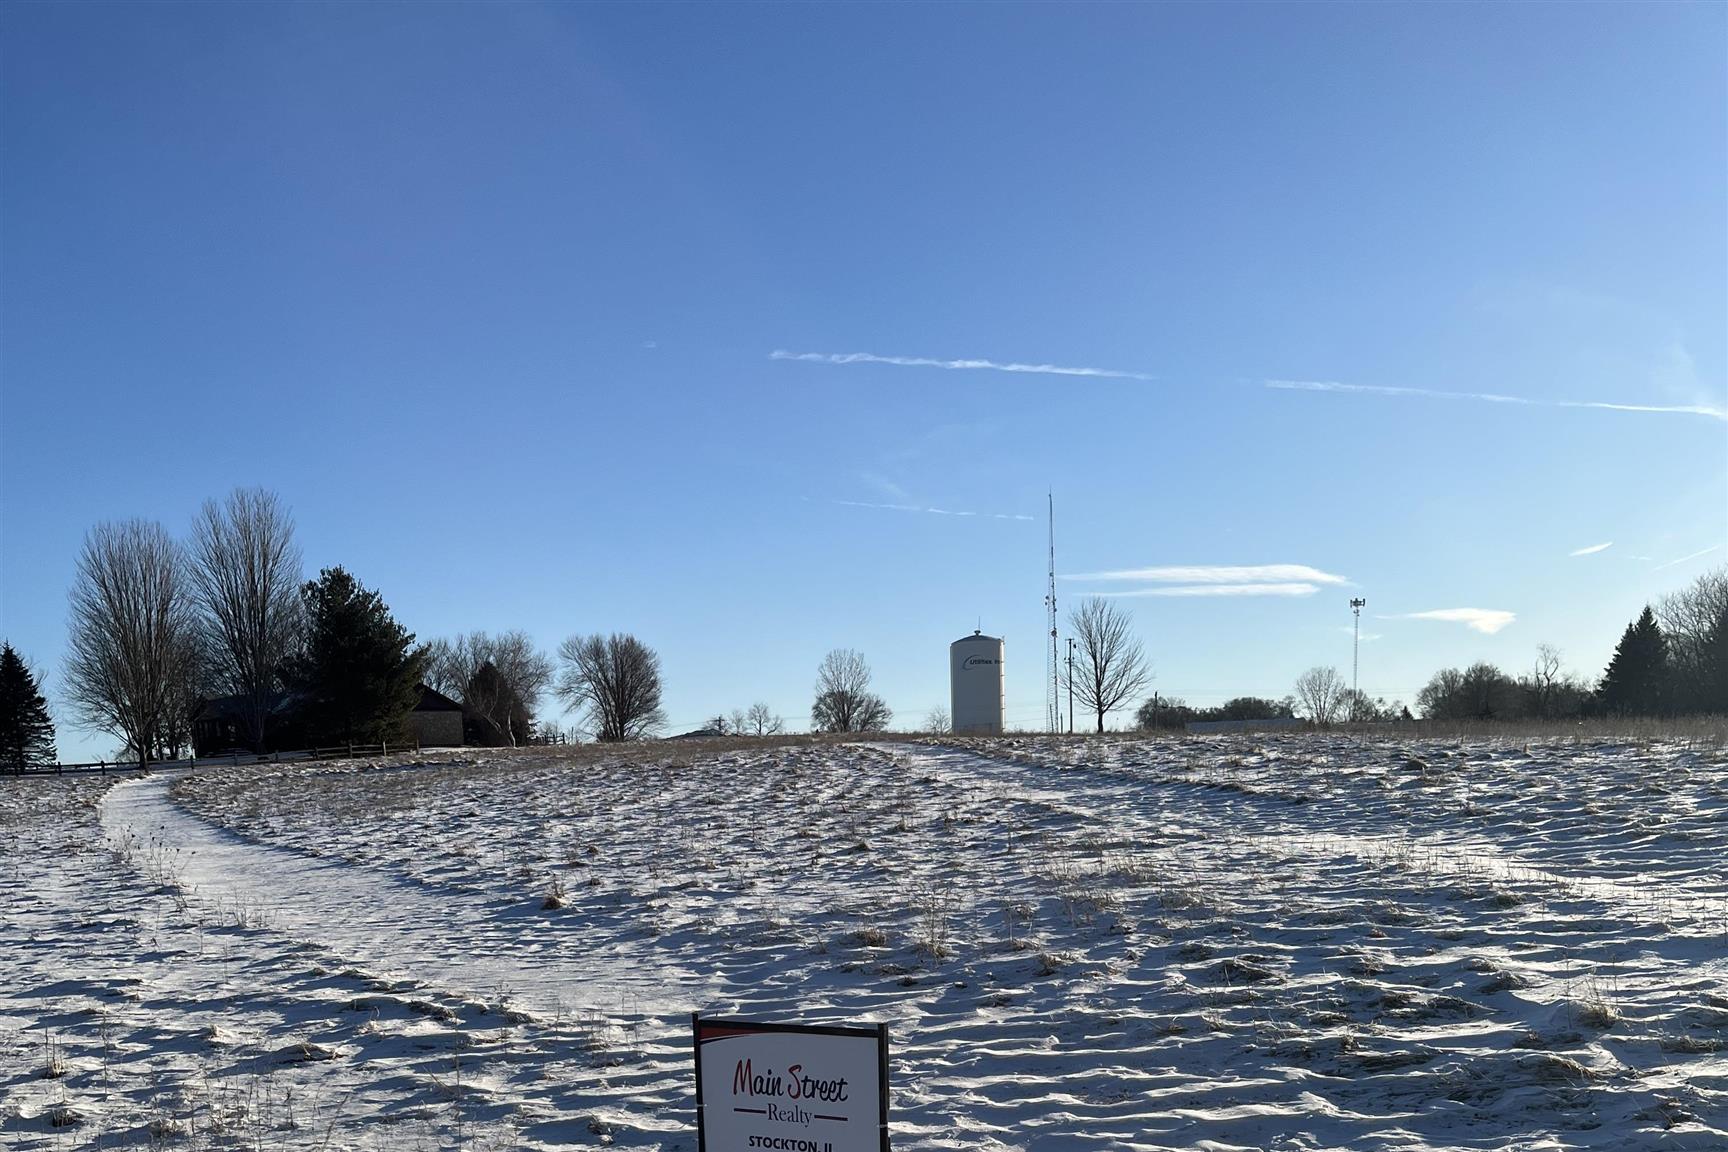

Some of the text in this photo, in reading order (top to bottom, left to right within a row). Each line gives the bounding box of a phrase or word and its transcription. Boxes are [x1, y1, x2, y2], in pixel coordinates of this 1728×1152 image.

[733, 1058, 848, 1102] Main Street
[767, 1103, 813, 1127] Realty
